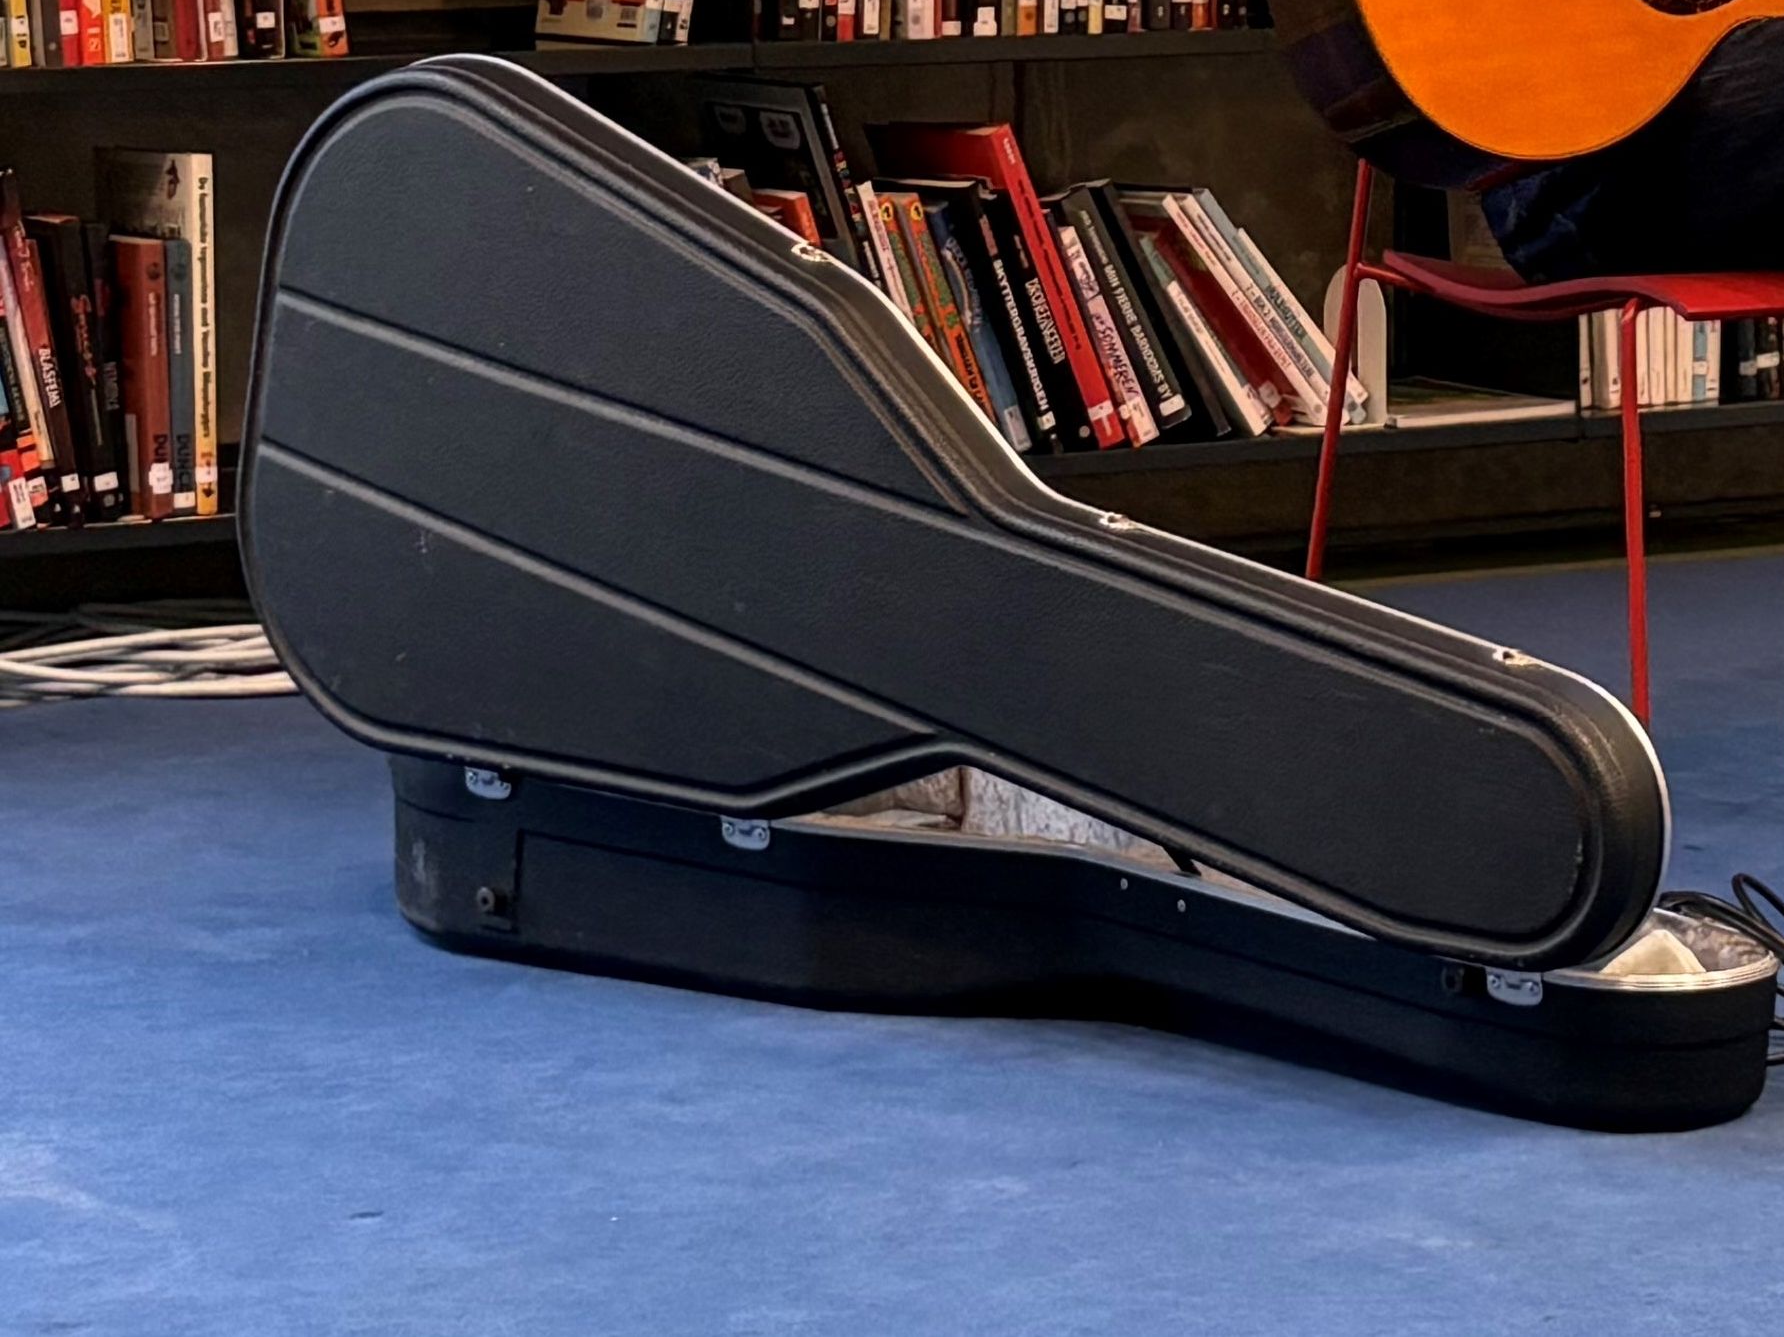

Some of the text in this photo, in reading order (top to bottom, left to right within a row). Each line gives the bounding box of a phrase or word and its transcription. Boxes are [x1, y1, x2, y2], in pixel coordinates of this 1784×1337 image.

[1101, 263, 1122, 287] MIN
[1111, 286, 1138, 326] FJERNE
[38, 347, 62, 408] BLASFEMI
[1155, 381, 1173, 399] BY
